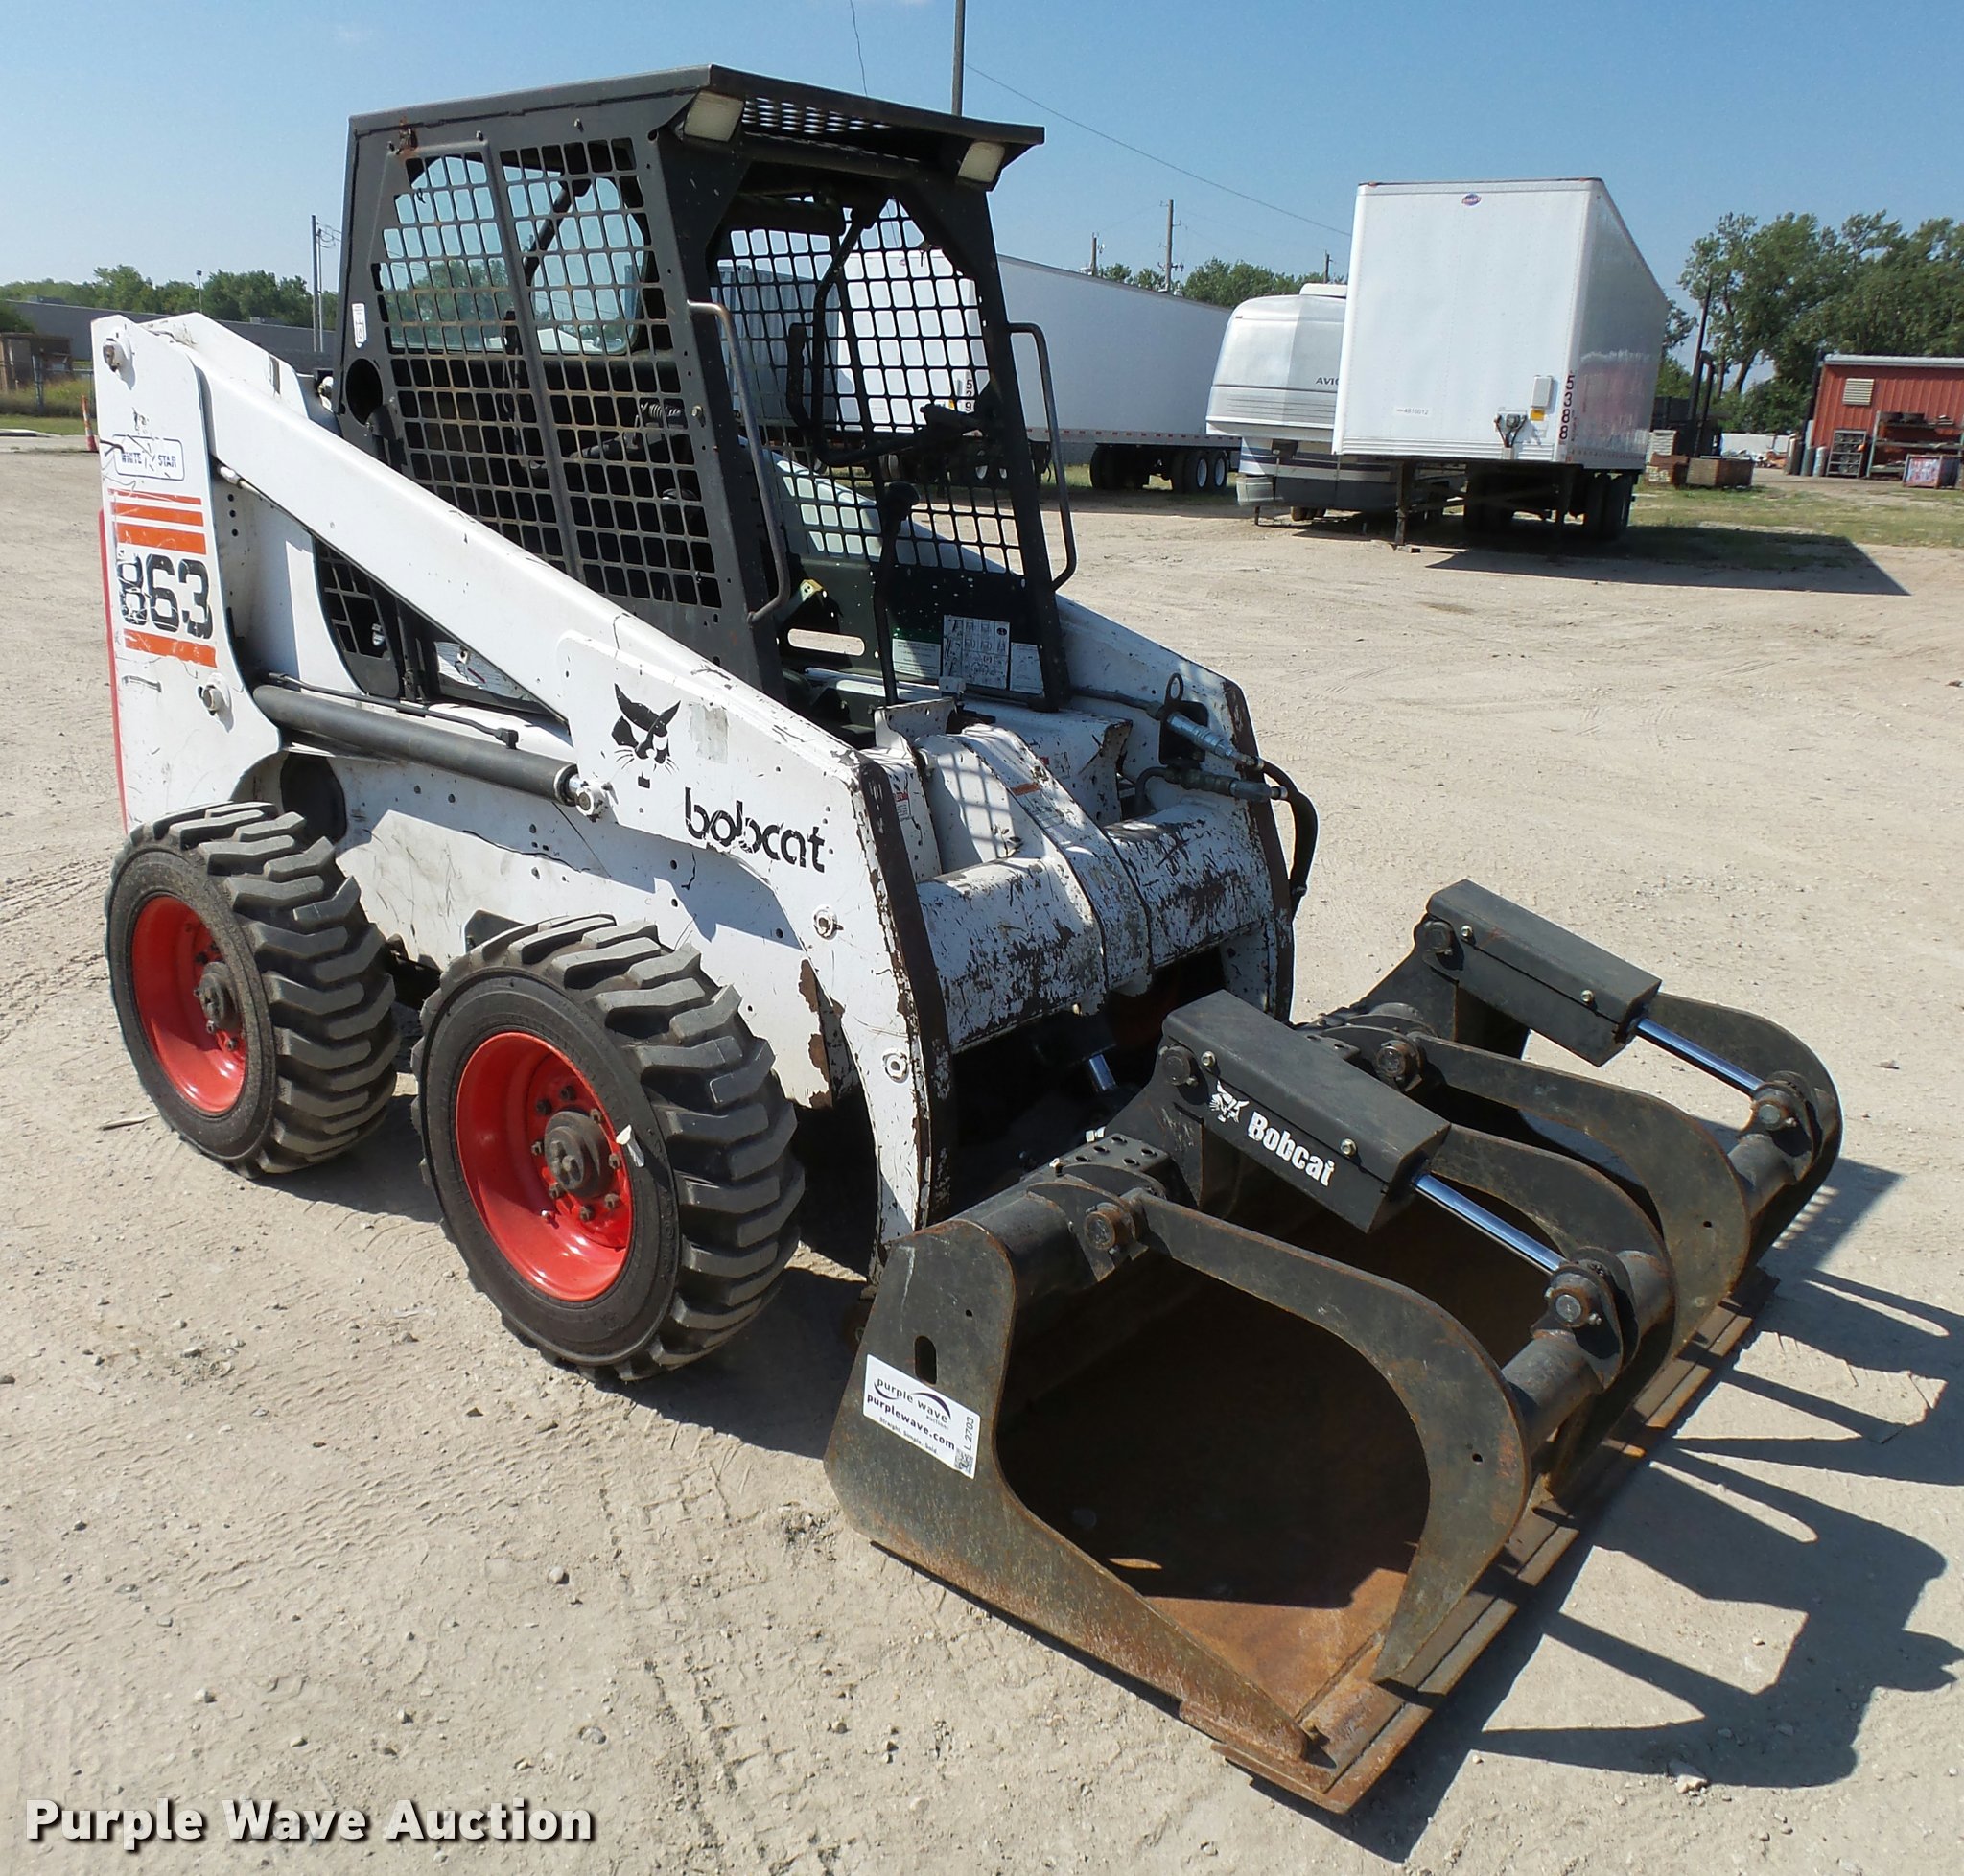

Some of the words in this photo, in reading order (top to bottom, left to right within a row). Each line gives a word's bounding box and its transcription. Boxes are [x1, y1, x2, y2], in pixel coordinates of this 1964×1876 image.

[157, 455, 176, 467] STAR
[116, 552, 213, 640] 863
[685, 786, 826, 874] bobcat
[1248, 1111, 1336, 1188] Bobcat
[867, 1394, 955, 1451] purplewave.com
[877, 1378, 914, 1404] purple
[917, 1400, 948, 1424] wave
